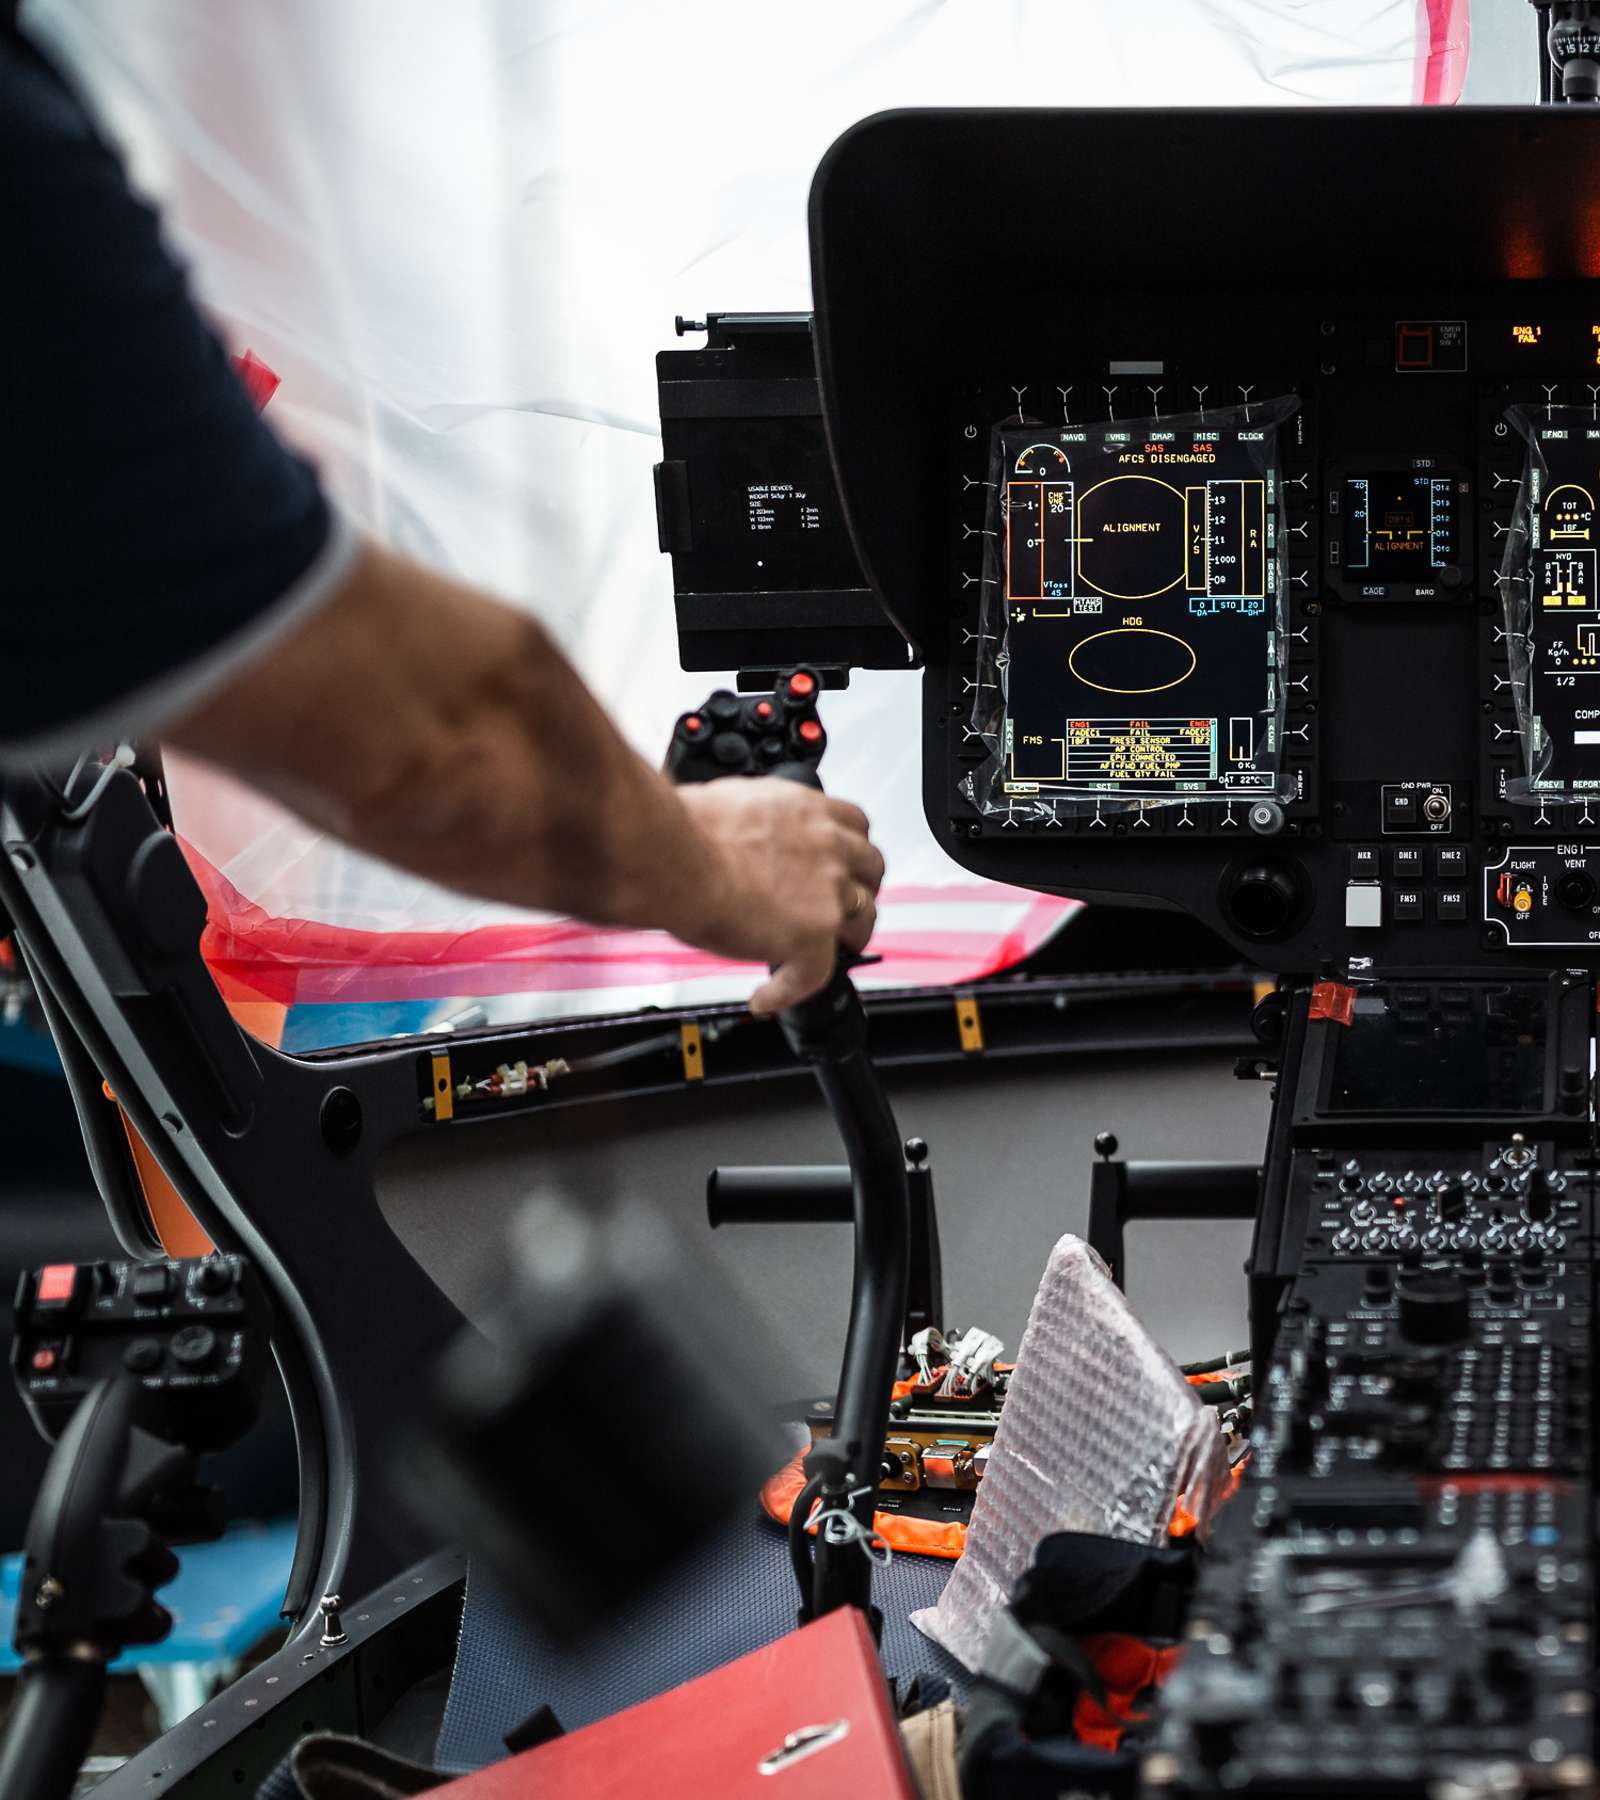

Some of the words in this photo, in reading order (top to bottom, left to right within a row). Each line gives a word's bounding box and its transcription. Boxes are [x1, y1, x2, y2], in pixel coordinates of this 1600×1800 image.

[1567, 44, 1575, 53] 15
[1579, 44, 1589, 52] 12
[1513, 326, 1533, 337] ENG
[1536, 327, 1541, 335] 1
[1517, 334, 1539, 343] FAIL
[1145, 444, 1164, 452] SAS
[1193, 444, 1212, 452] SAS
[1119, 454, 1144, 463] AFCS
[1151, 454, 1215, 463] DISENGAGED
[1215, 496, 1225, 504] 13
[1051, 504, 1063, 512] 20
[1215, 516, 1225, 524] 12
[1103, 523, 1160, 532] ALIGNMENT
[1215, 536, 1224, 544] 11
[1375, 542, 1424, 550] ALIGNMENT
[1215, 556, 1235, 564] 1000
[1213, 576, 1225, 584] 09
[1050, 590, 1063, 598] 45
[1123, 617, 1142, 625] HDG
[1548, 647, 1569, 656] Kg/h
[1557, 677, 1575, 686] 1/2
[1069, 720, 1091, 729] ENG1
[1128, 720, 1151, 729] FAIL
[1070, 729, 1101, 737] FADEC1
[1128, 728, 1151, 737] FAIL
[1023, 736, 1042, 744] FMS
[1109, 737, 1140, 745] PRESS
[1140, 737, 1171, 745] SENSOR
[1129, 745, 1166, 753] CONTROL
[1129, 753, 1177, 762] CONNECTED
[1139, 762, 1162, 770] FUEL
[1162, 761, 1182, 770] PMP
[1219, 776, 1234, 784] OAT
[1394, 798, 1408, 806] GND
[1557, 845, 1577, 855] ENG
[1580, 845, 1583, 855] I
[1414, 851, 1417, 859] 1
[1456, 851, 1461, 859] 2
[1511, 861, 1536, 869] FLIGHT
[1565, 860, 1586, 868] VENT
[1516, 912, 1530, 920] OFF
